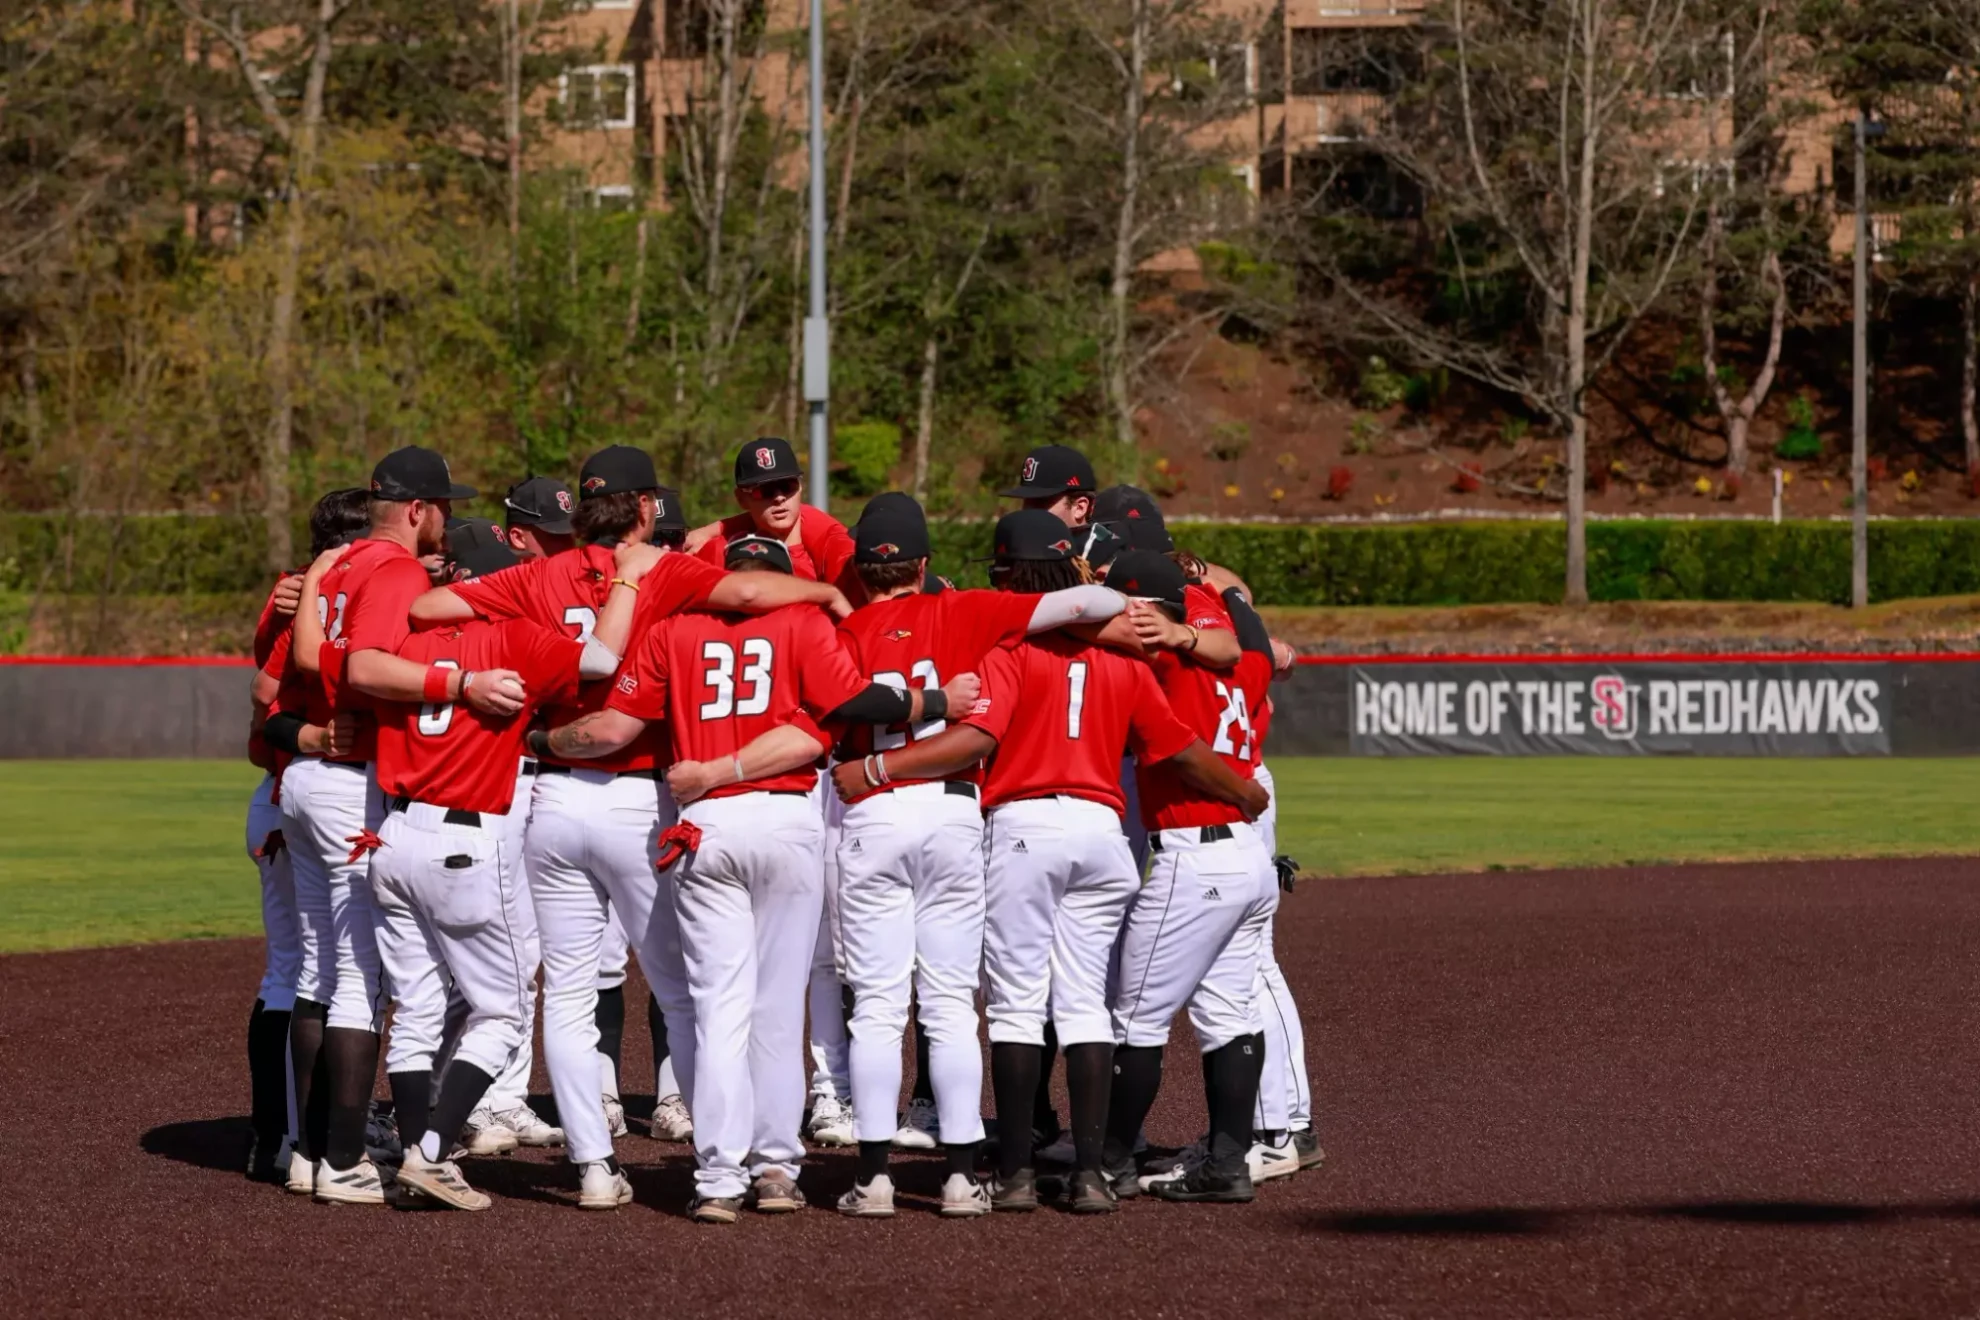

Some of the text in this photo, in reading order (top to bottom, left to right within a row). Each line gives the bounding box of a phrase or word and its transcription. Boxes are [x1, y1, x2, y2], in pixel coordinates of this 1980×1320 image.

[700, 637, 775, 721] 33
[872, 658, 946, 752] 22
[1066, 661, 1088, 740] 1
[1212, 679, 1251, 761] 29
[1356, 681, 1459, 735] HOME
[1465, 680, 1511, 736] OF
[1516, 681, 1585, 735] THE
[1648, 679, 1880, 735] REDHAWKS
